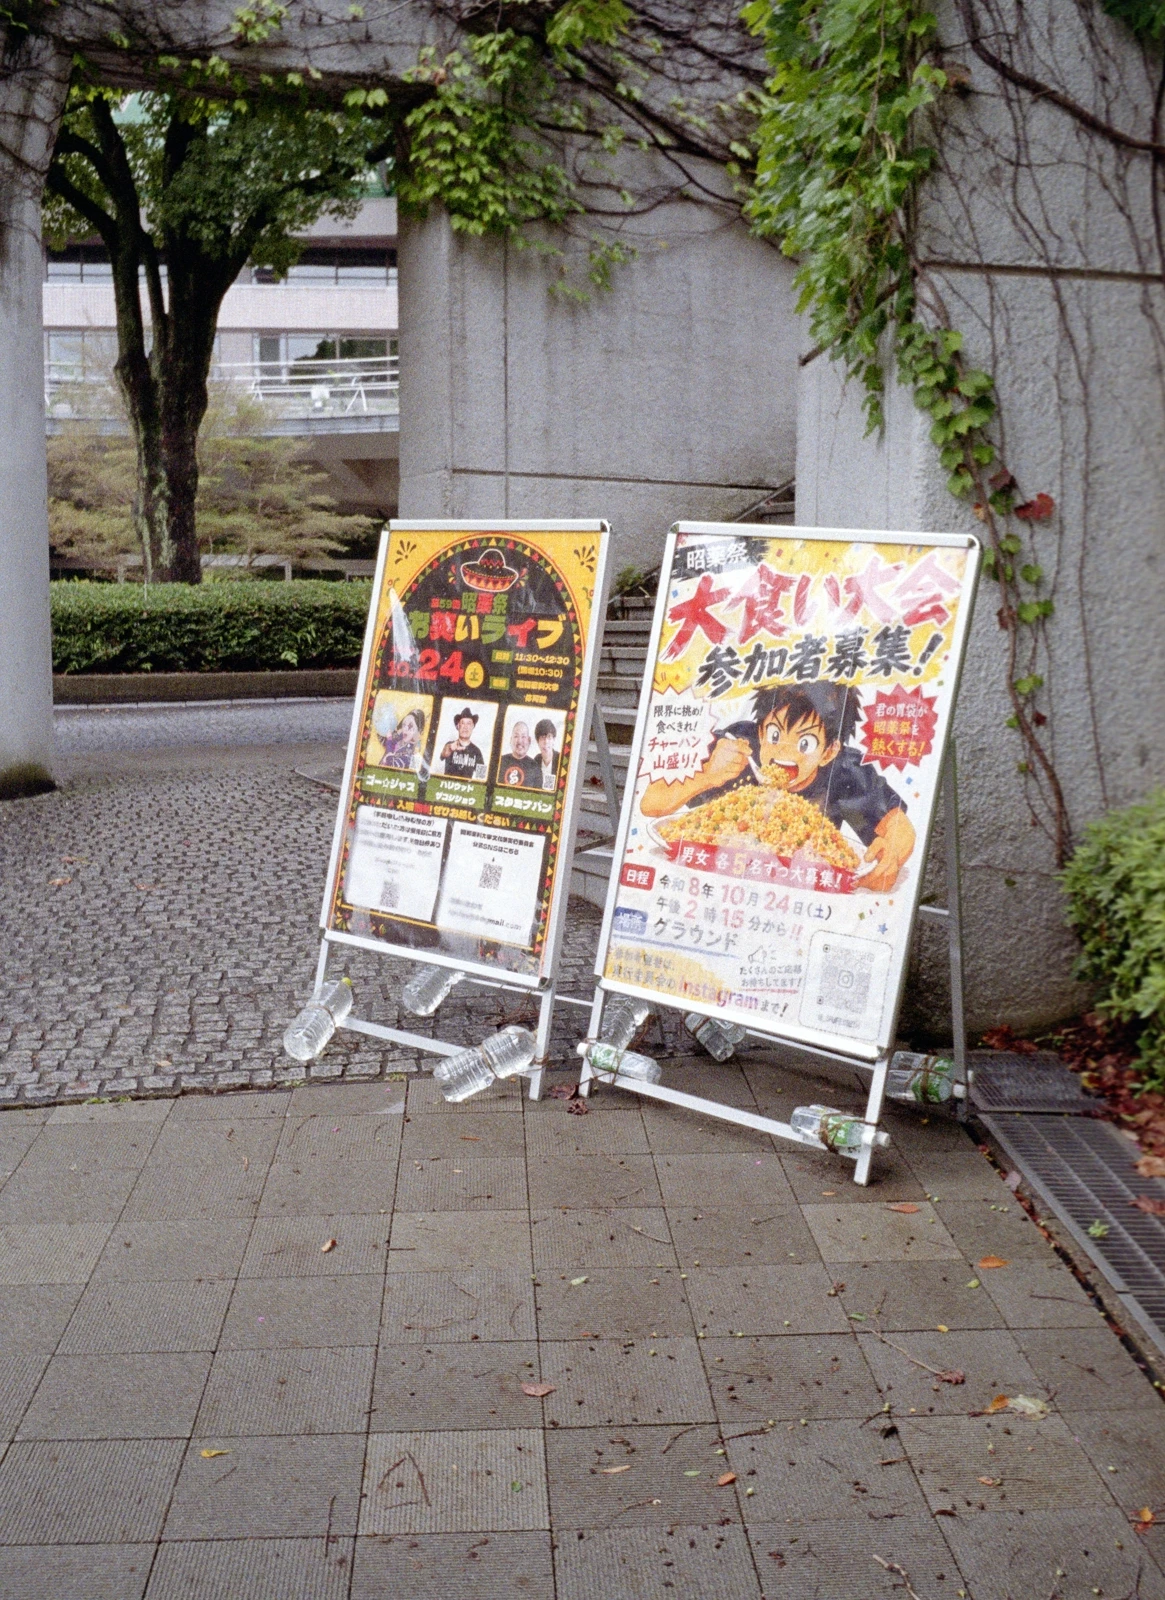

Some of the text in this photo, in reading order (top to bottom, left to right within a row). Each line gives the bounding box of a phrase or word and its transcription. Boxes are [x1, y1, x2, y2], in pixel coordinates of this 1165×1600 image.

[686, 542, 749, 570] 昭薬祭
[660, 554, 962, 661] 大食い大会
[408, 611, 567, 649] お笑いライブ
[696, 625, 943, 699] 参加者募集!
[654, 705, 703, 717] 限界に挑め!
[876, 703, 928, 718] 君の胃袋が
[656, 720, 698, 734] 食べきれ!
[648, 736, 701, 752] チャーハン
[872, 737, 926, 757] 熱くする!
[653, 752, 698, 770] 山盛り!
[626, 869, 649, 885] 日程
[653, 917, 739, 950] グラウンド
